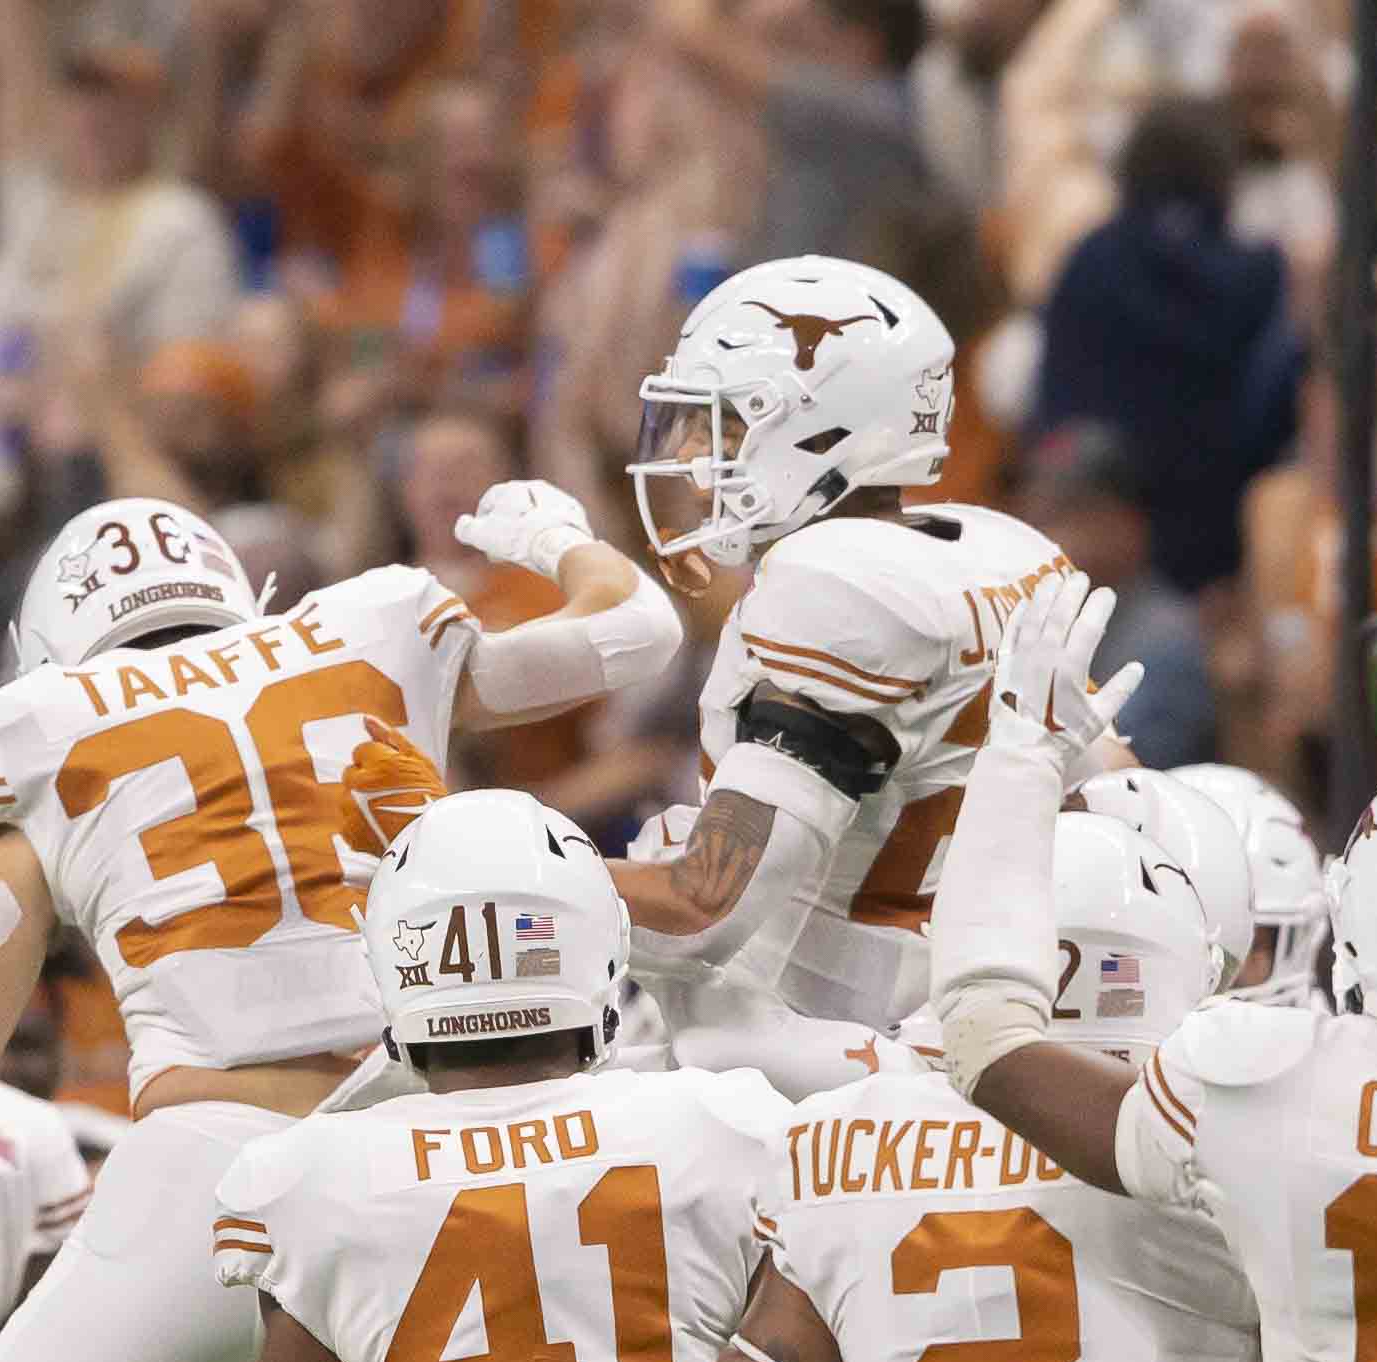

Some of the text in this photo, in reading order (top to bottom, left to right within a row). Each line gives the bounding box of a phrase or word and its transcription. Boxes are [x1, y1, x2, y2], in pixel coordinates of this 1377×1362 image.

[108, 582, 225, 622] LONGHORNS
[64, 603, 344, 718] TAAFFE
[439, 902, 502, 982] 41
[427, 1007, 551, 1037] LONGHORNS
[412, 1110, 599, 1181] FORD
